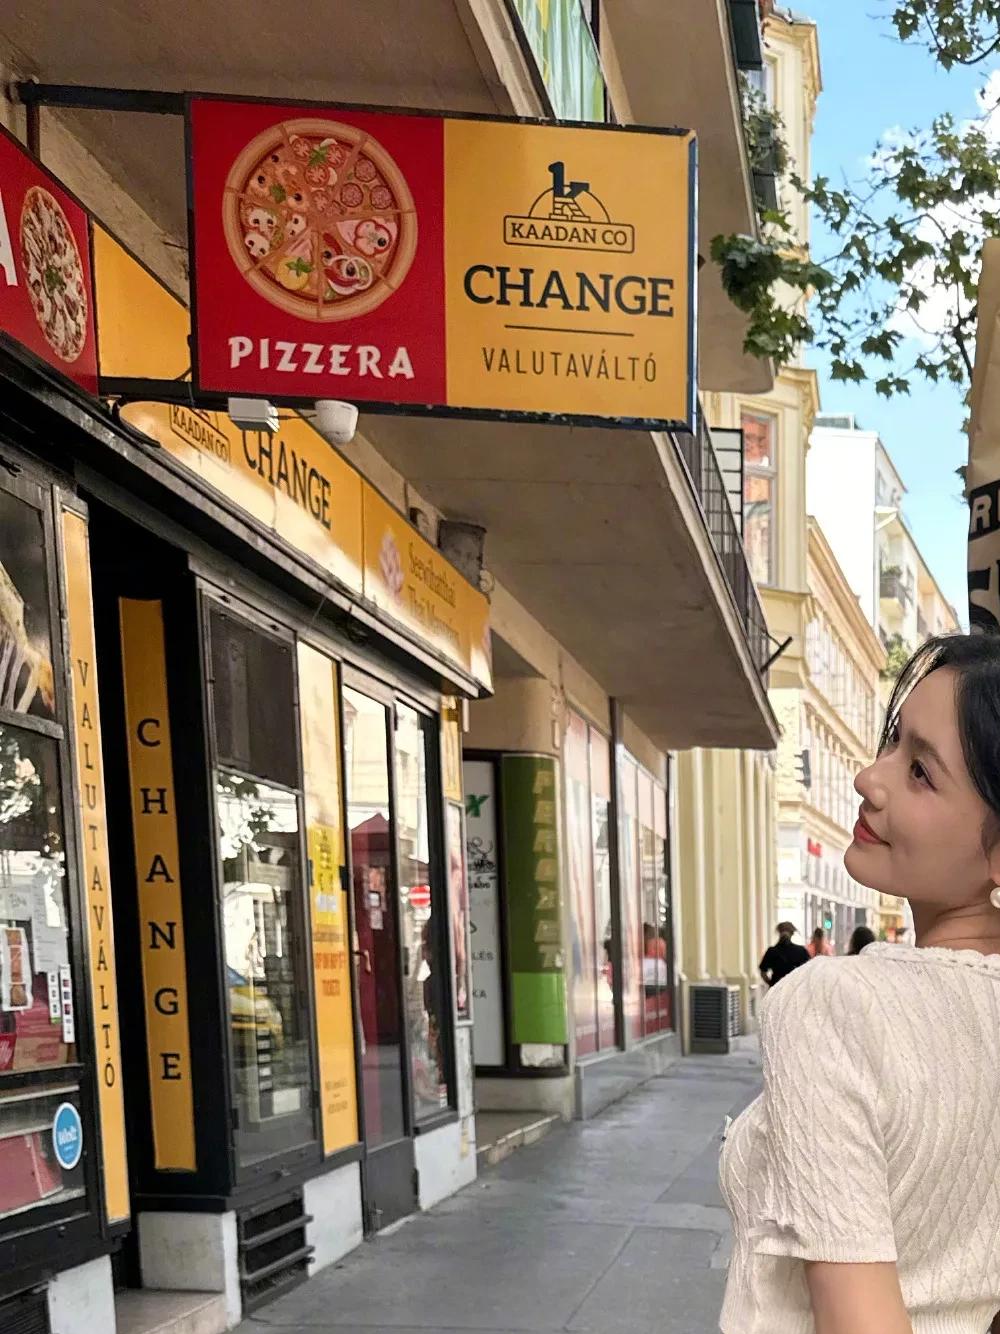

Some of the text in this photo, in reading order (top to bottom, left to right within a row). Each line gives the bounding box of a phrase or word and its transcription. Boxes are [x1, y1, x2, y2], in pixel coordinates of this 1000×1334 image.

[511, 222, 627, 246] KAADAN CO
[464, 264, 674, 317] CHANGE
[228, 336, 415, 380] PIZZERA
[482, 347, 657, 382] VALUTAVÁLTÓ
[173, 404, 228, 463] KAADAN CO
[242, 430, 332, 531] CHANGE
[77, 659, 115, 1088] VALUTAVÁLTÓ
[136, 718, 182, 1081] CHANGE
